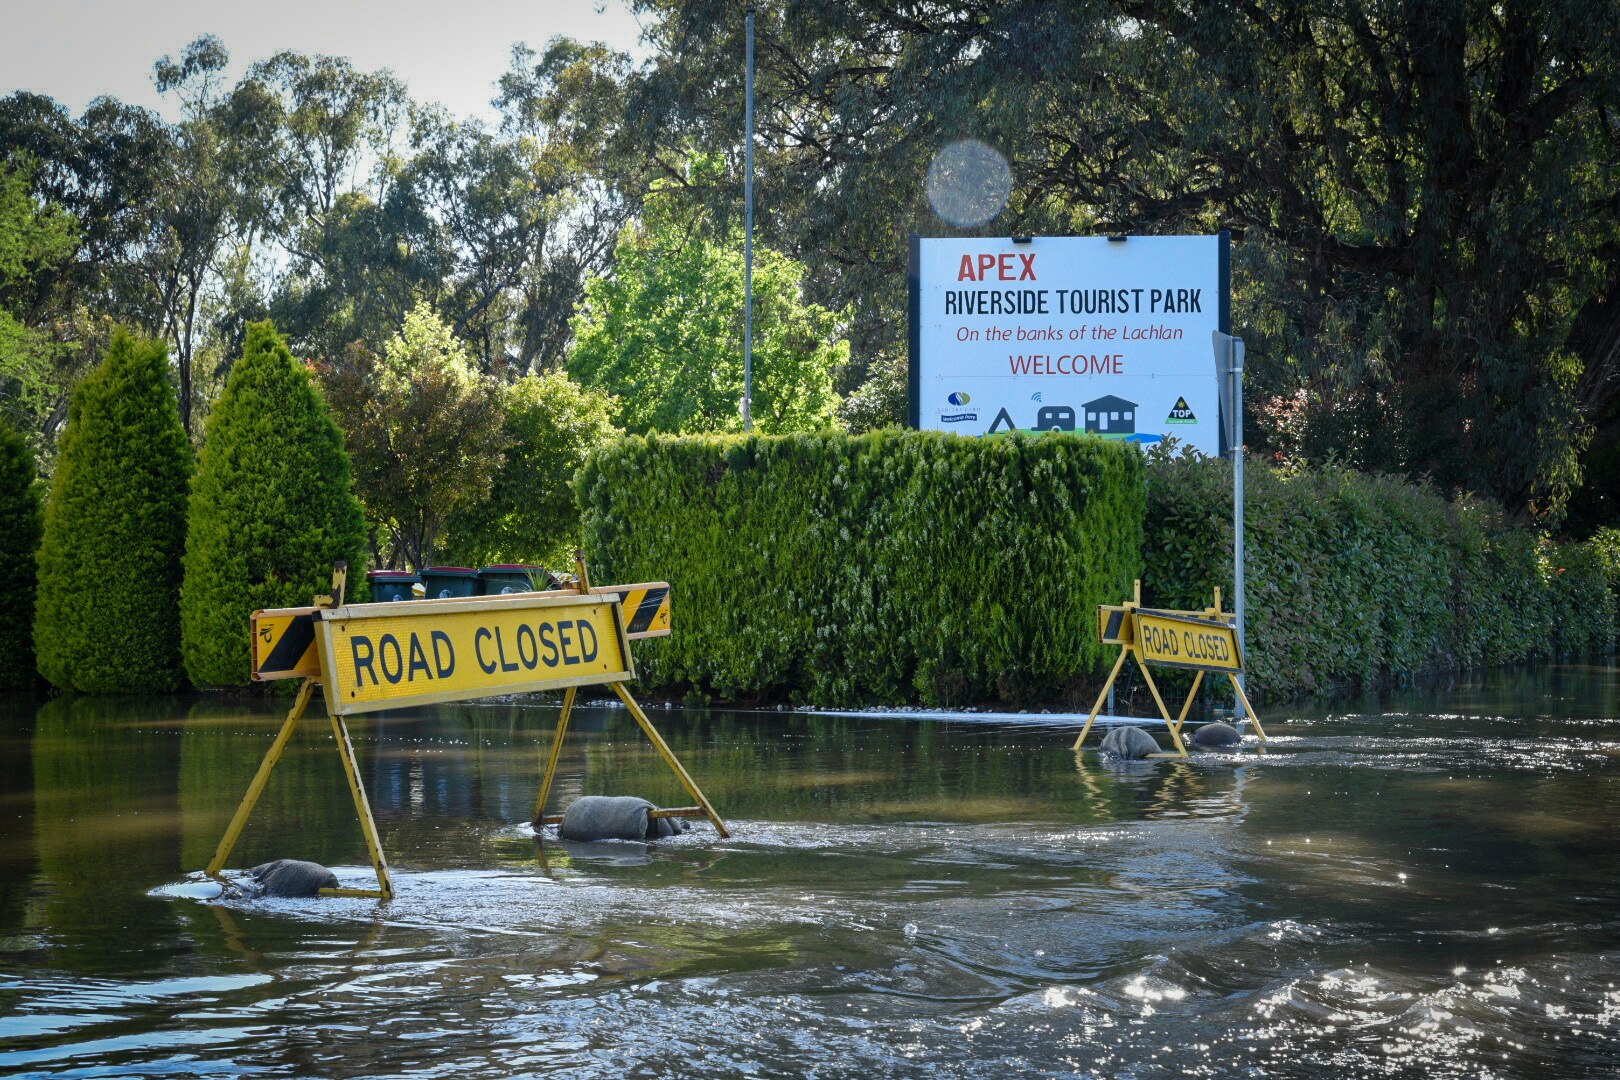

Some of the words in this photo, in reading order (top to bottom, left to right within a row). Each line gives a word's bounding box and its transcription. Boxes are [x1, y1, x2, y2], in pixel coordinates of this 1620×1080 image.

[957, 253, 1037, 282] APEX
[945, 290, 1049, 314] RIVERSIDE
[1056, 289, 1144, 314] TOURIST
[1151, 289, 1202, 313] PARK
[956, 326, 980, 342] On
[986, 326, 1011, 341] the
[1017, 325, 1063, 341] banks
[1069, 325, 1086, 340] of
[1091, 325, 1116, 340] the
[1122, 324, 1183, 340] Lachlan
[1009, 354, 1124, 375] WELCOME
[1172, 409, 1191, 418] TOP
[350, 630, 456, 687] ROAD
[475, 619, 598, 675] CLOSED
[1144, 625, 1179, 655] ROAD
[1184, 632, 1229, 661] CLOSED
